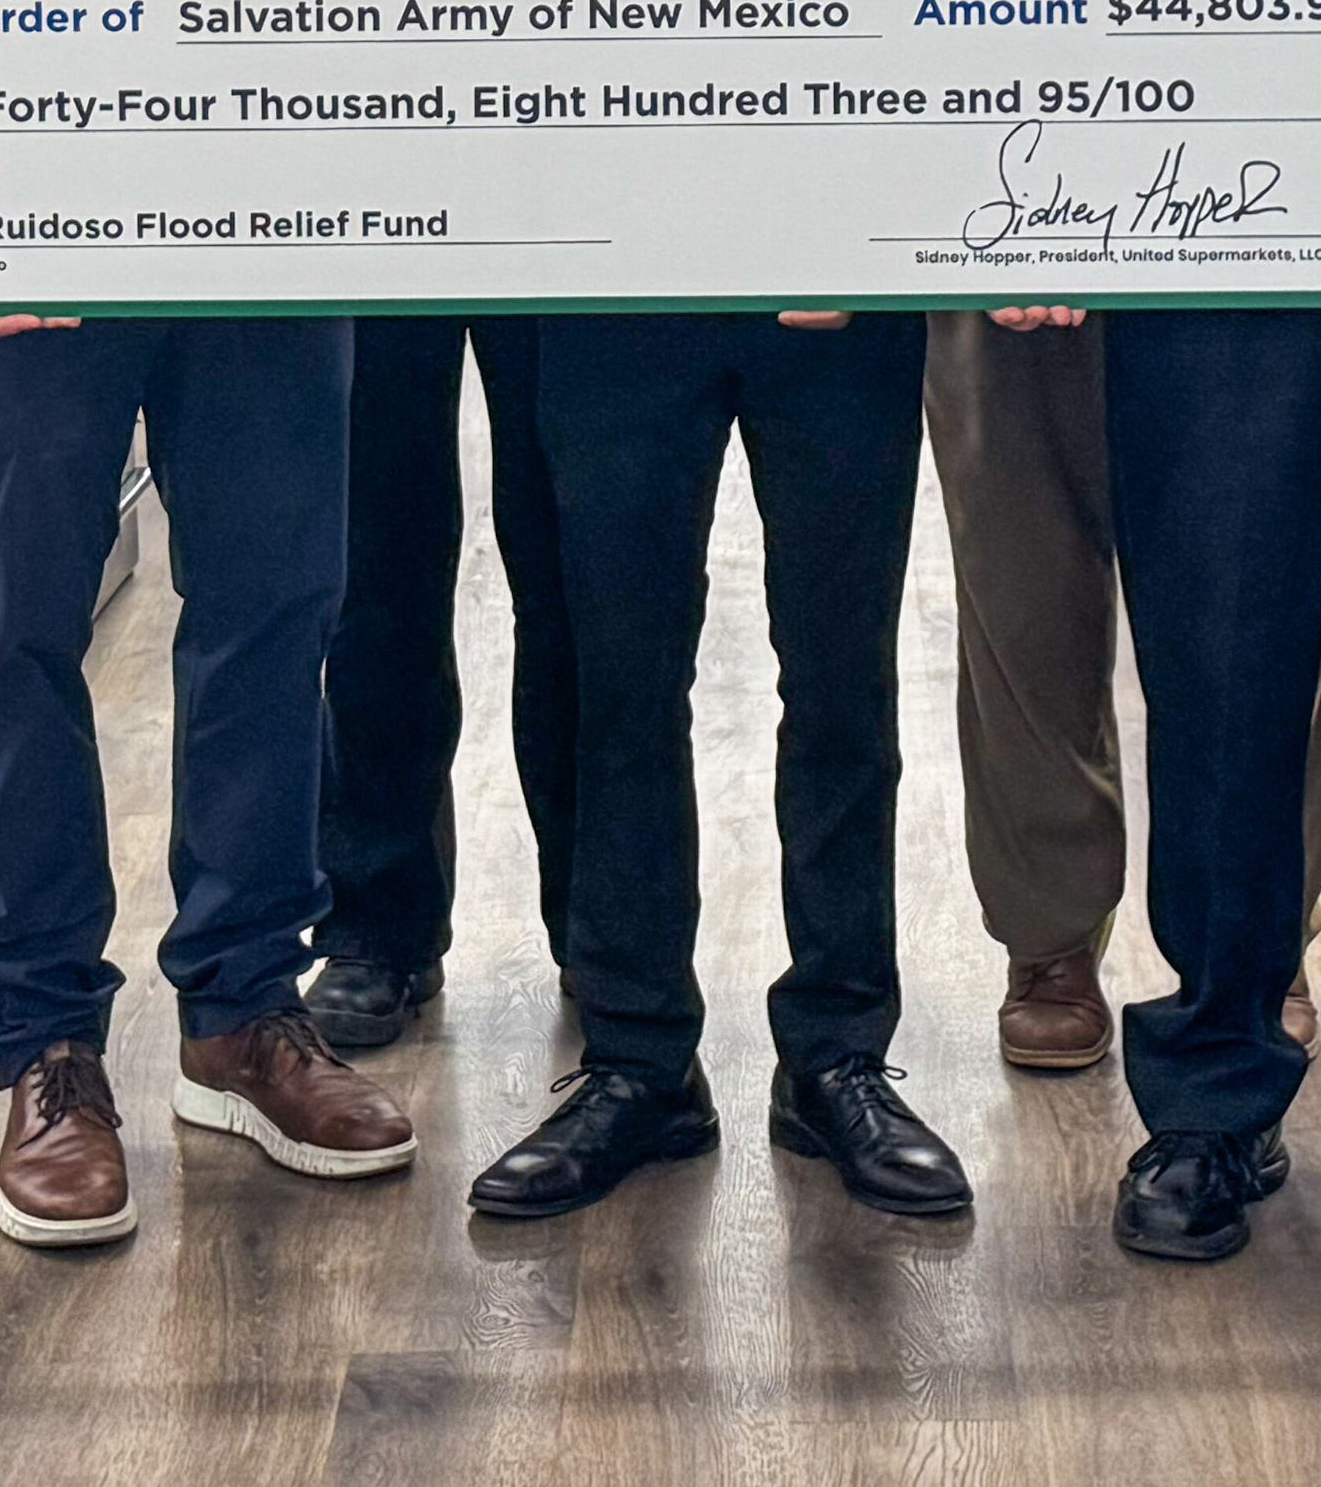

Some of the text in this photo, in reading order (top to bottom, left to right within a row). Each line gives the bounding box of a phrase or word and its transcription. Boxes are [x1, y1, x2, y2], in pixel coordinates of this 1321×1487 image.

[102, 0, 144, 32] of
[231, 86, 456, 125] Thousand,
[472, 85, 586, 124] Eight
[603, 81, 788, 119] Hundred
[804, 81, 927, 115] Three
[941, 80, 1023, 114] and
[1038, 77, 1195, 119] 95/100
[136, 211, 236, 239] Flood
[250, 209, 350, 238] Relief
[361, 208, 448, 237] Fund
[915, 251, 969, 266] Sidney
[973, 250, 1035, 265] Hopper,
[1039, 249, 1118, 263] President,
[1122, 248, 1174, 262] United
[1178, 248, 1295, 263] Supermarkets,
